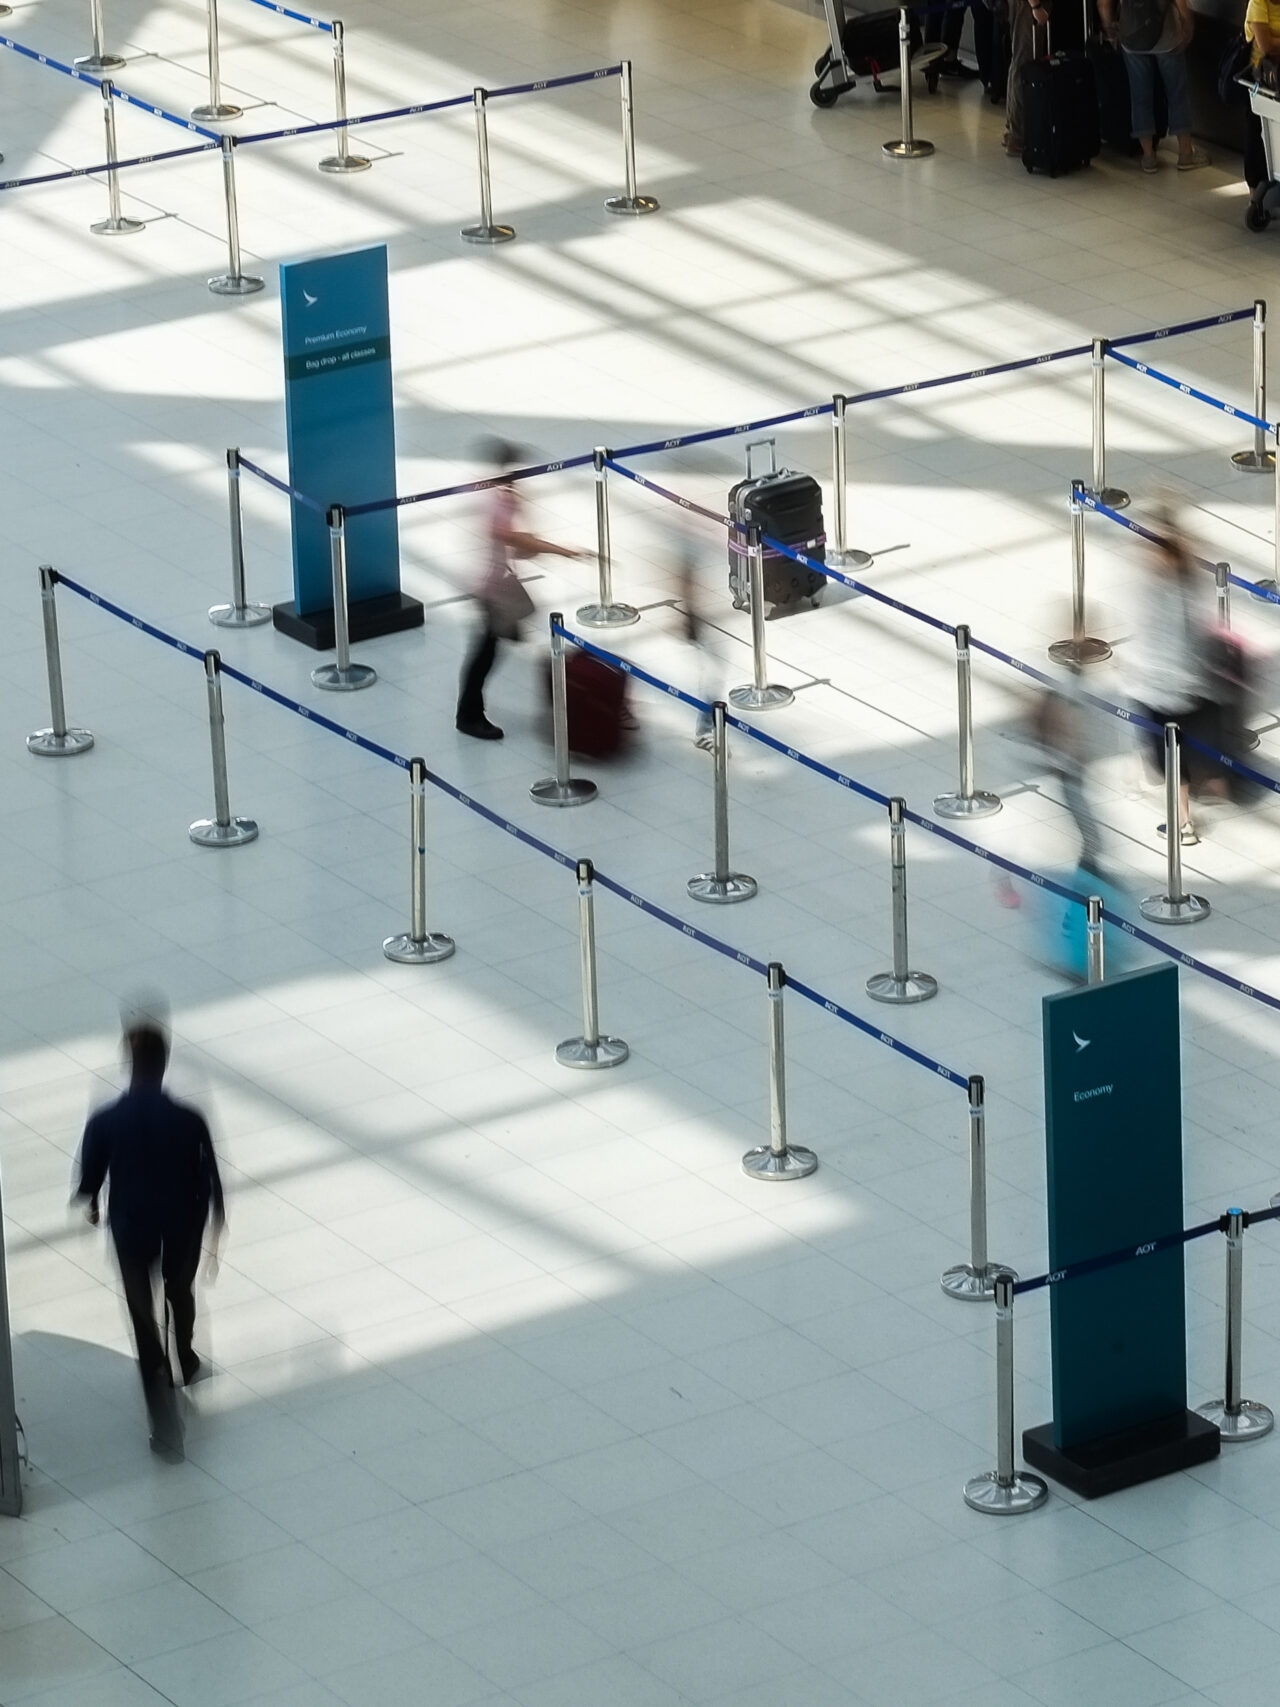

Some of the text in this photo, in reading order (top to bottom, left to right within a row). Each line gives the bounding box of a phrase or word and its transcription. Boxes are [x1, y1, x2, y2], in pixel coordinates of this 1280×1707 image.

[593, 71, 608, 79] AOT
[533, 82, 548, 90] AOT
[1218, 314, 1234, 323] AOT
[305, 325, 367, 345] Premium Economy
[1154, 330, 1170, 338] AOT
[305, 360, 320, 370] Bag
[321, 355, 337, 366] drop
[342, 352, 350, 361] all
[350, 347, 376, 359] classes
[1036, 356, 1053, 364] AOT
[1136, 363, 1148, 374] AOT
[1179, 384, 1191, 395] AOT
[804, 407, 820, 416] AOT
[1224, 404, 1236, 415] AOT
[734, 425, 750, 433] AOT
[665, 439, 681, 448] AOT
[547, 463, 563, 471] AOT
[634, 474, 646, 484] AOT
[474, 481, 491, 490] AOT
[400, 496, 417, 504] AOT
[679, 498, 691, 508] AOT
[1084, 496, 1096, 508] AOT
[723, 518, 735, 528] AOT
[1128, 521, 1140, 531] AOT
[796, 554, 808, 565] AOT
[843, 578, 856, 588] AOT
[1266, 591, 1280, 603] AOT
[573, 636, 585, 648] AOT
[620, 661, 631, 672] AOT
[1010, 659, 1024, 669] AOT
[667, 686, 679, 696] AOT
[298, 706, 310, 717] AOT
[1116, 709, 1131, 719] AOT
[738, 721, 750, 733] AOT
[345, 731, 358, 742] AOT
[787, 749, 799, 760] AOT
[394, 755, 407, 766] AOT
[838, 775, 851, 786] AOT
[458, 793, 471, 805] AOT
[505, 823, 518, 835] AOT
[921, 819, 933, 830] AOT
[974, 846, 989, 858] AOT
[553, 853, 566, 863] AOT
[1030, 873, 1045, 885] AOT
[630, 894, 644, 907] AOT
[682, 924, 696, 936] AOT
[1121, 922, 1136, 935] AOT
[736, 953, 751, 965] AOT
[1180, 953, 1195, 966] AOT
[1239, 984, 1253, 995] AOT
[824, 1001, 838, 1013] AOT
[880, 1033, 894, 1046] AOT
[937, 1066, 951, 1079] AOT
[1074, 1084, 1113, 1102] Economy
[1135, 1242, 1156, 1256] AOT
[1045, 1270, 1067, 1283] AOT
